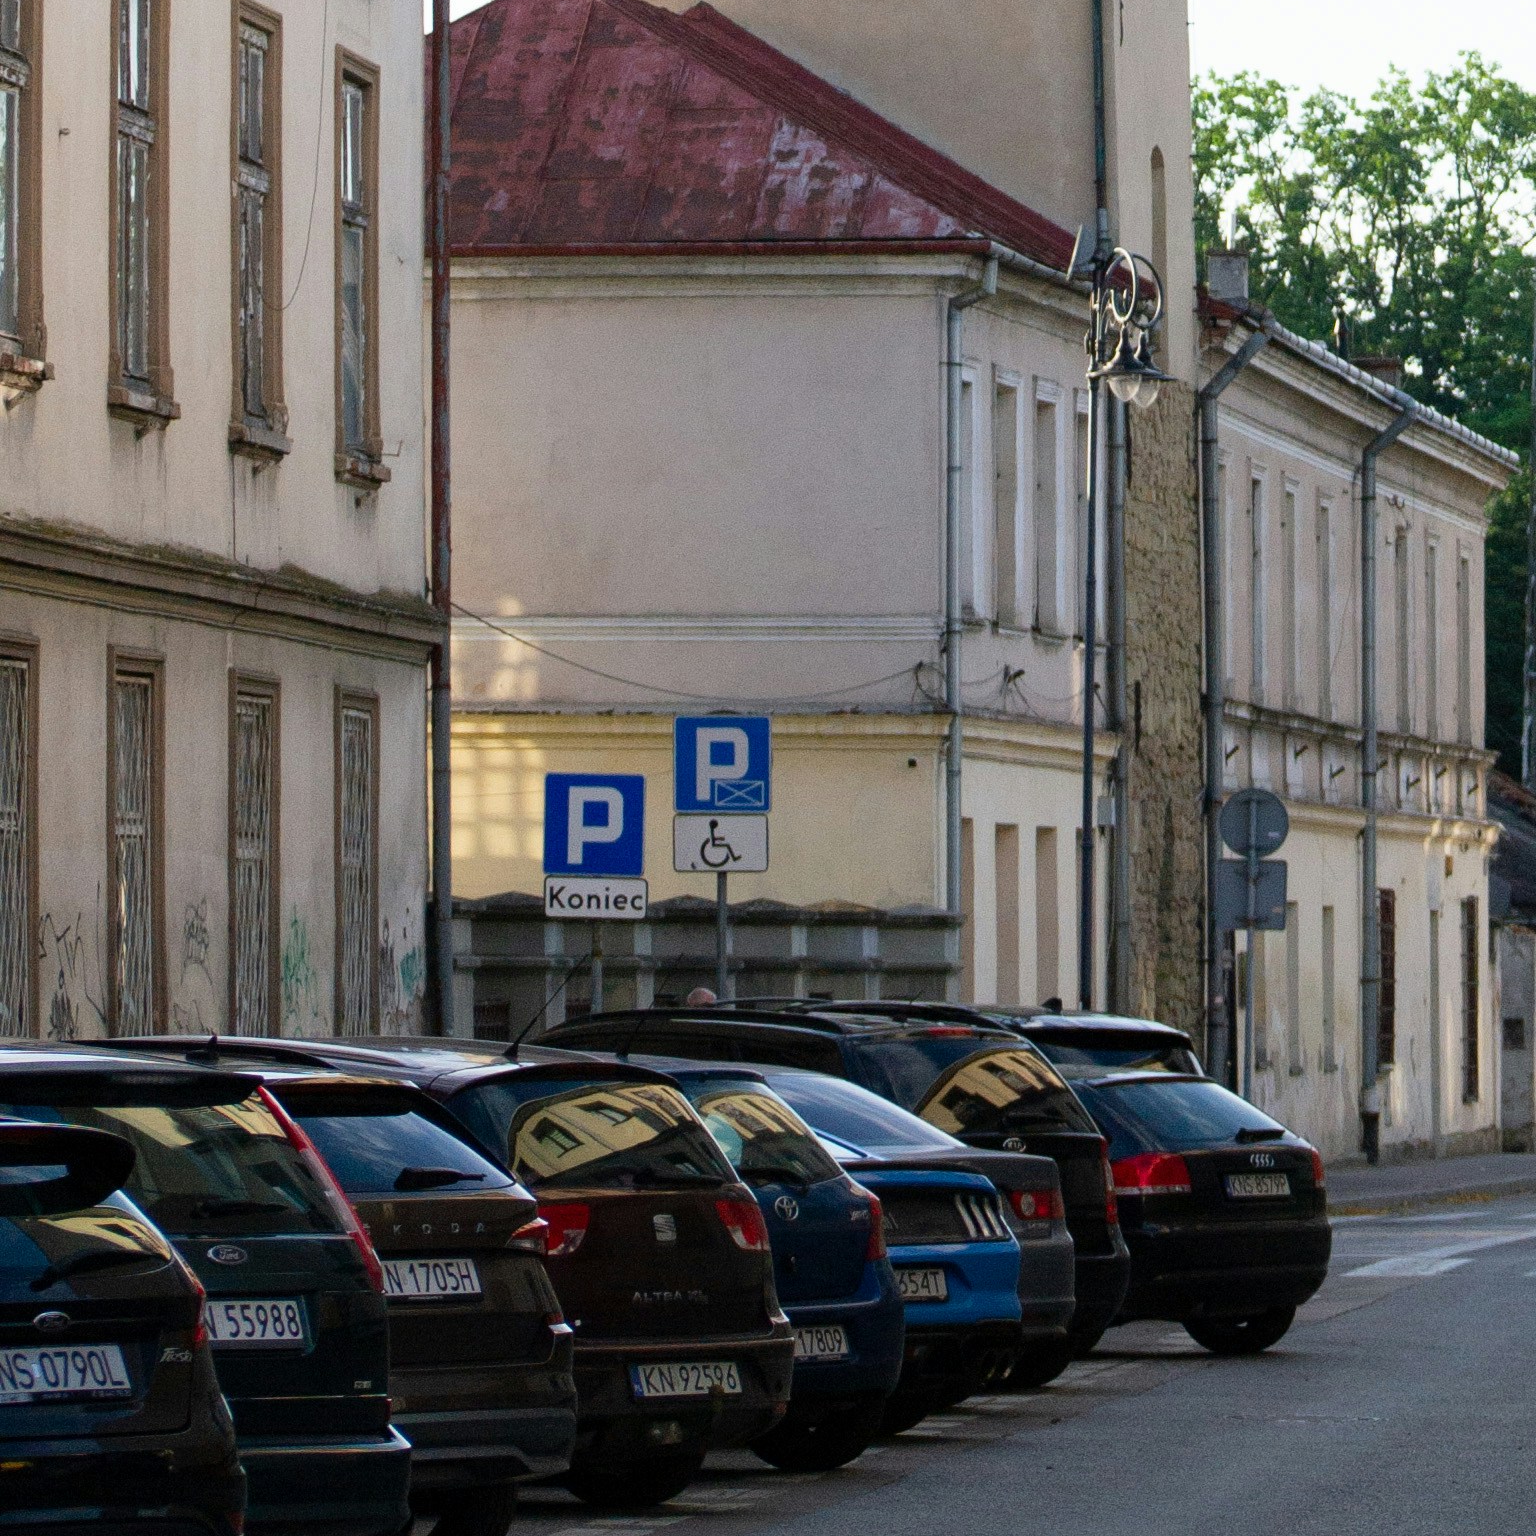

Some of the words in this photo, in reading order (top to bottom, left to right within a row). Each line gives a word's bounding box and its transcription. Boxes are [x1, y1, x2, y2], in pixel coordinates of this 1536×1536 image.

[696, 726, 749, 801] P
[566, 785, 625, 866] P
[548, 885, 644, 911] Koniec
[1231, 1175, 1254, 1195] KNS
[382, 1263, 403, 1293] N
[408, 1262, 475, 1293] 1705H
[223, 1304, 300, 1338] 55988
[797, 1329, 843, 1354] 17809
[39, 1350, 125, 1388] 0790L
[642, 1366, 676, 1393] KN
[678, 1364, 737, 1392] 92596
